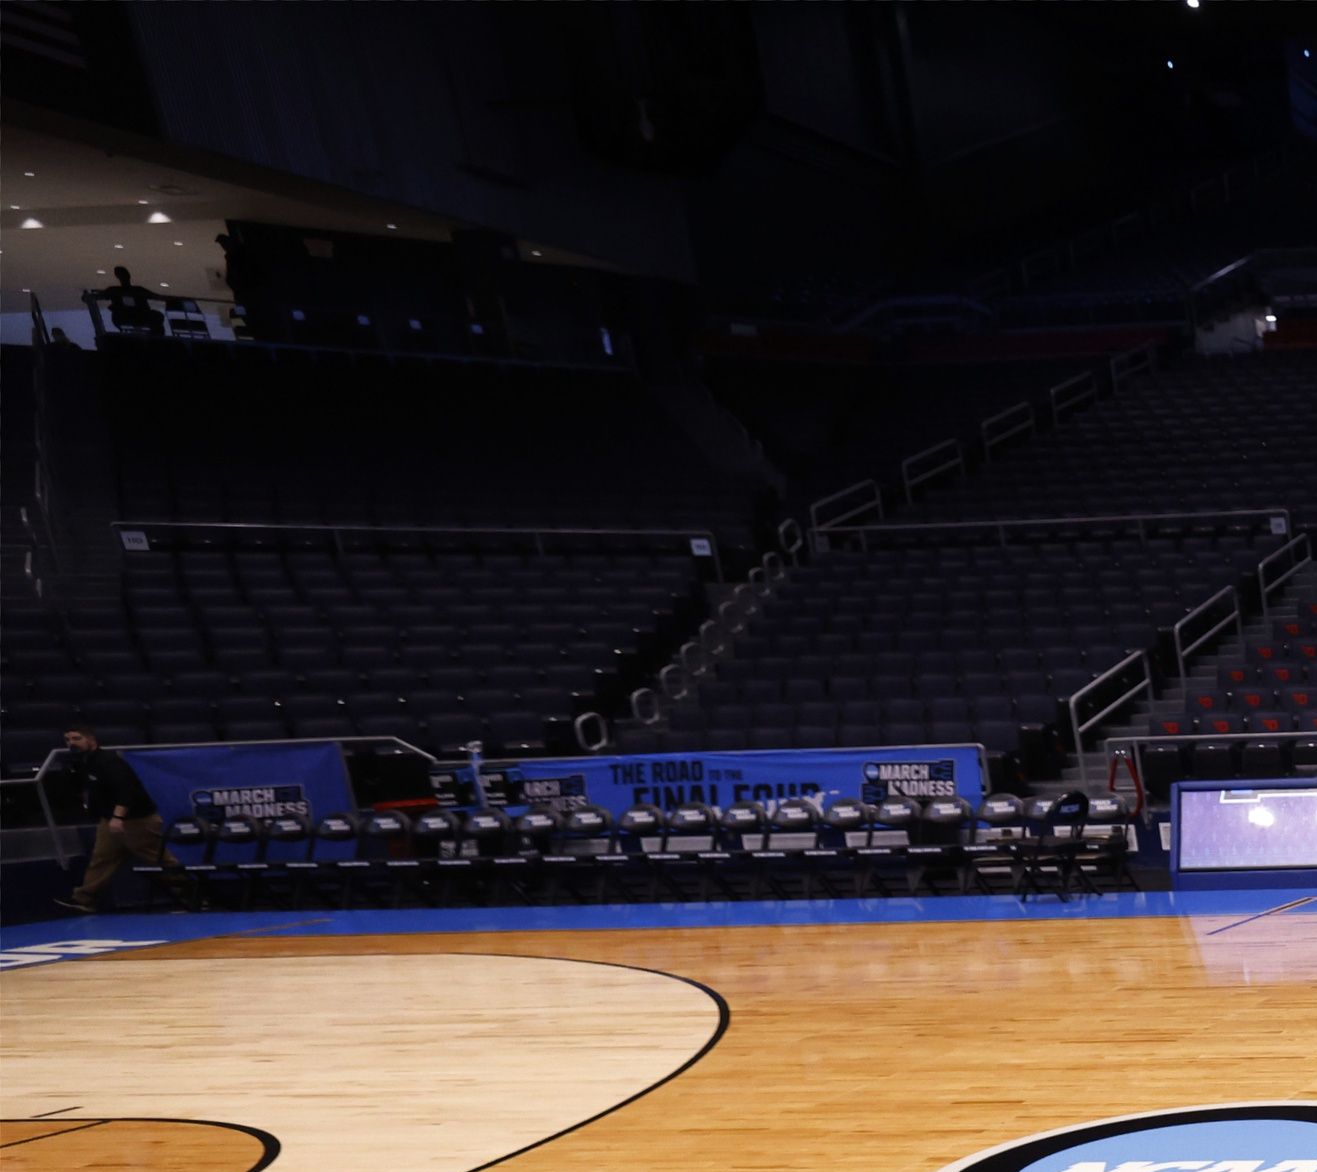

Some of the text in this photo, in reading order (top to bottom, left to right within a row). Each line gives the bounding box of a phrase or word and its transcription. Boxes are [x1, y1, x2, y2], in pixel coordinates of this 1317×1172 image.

[609, 763, 645, 785] THE
[652, 761, 703, 783] ROAD
[880, 764, 929, 780] MARCH
[888, 780, 955, 796] MADNESS
[213, 788, 275, 806] MARCH
[224, 801, 308, 818] MADNESS
